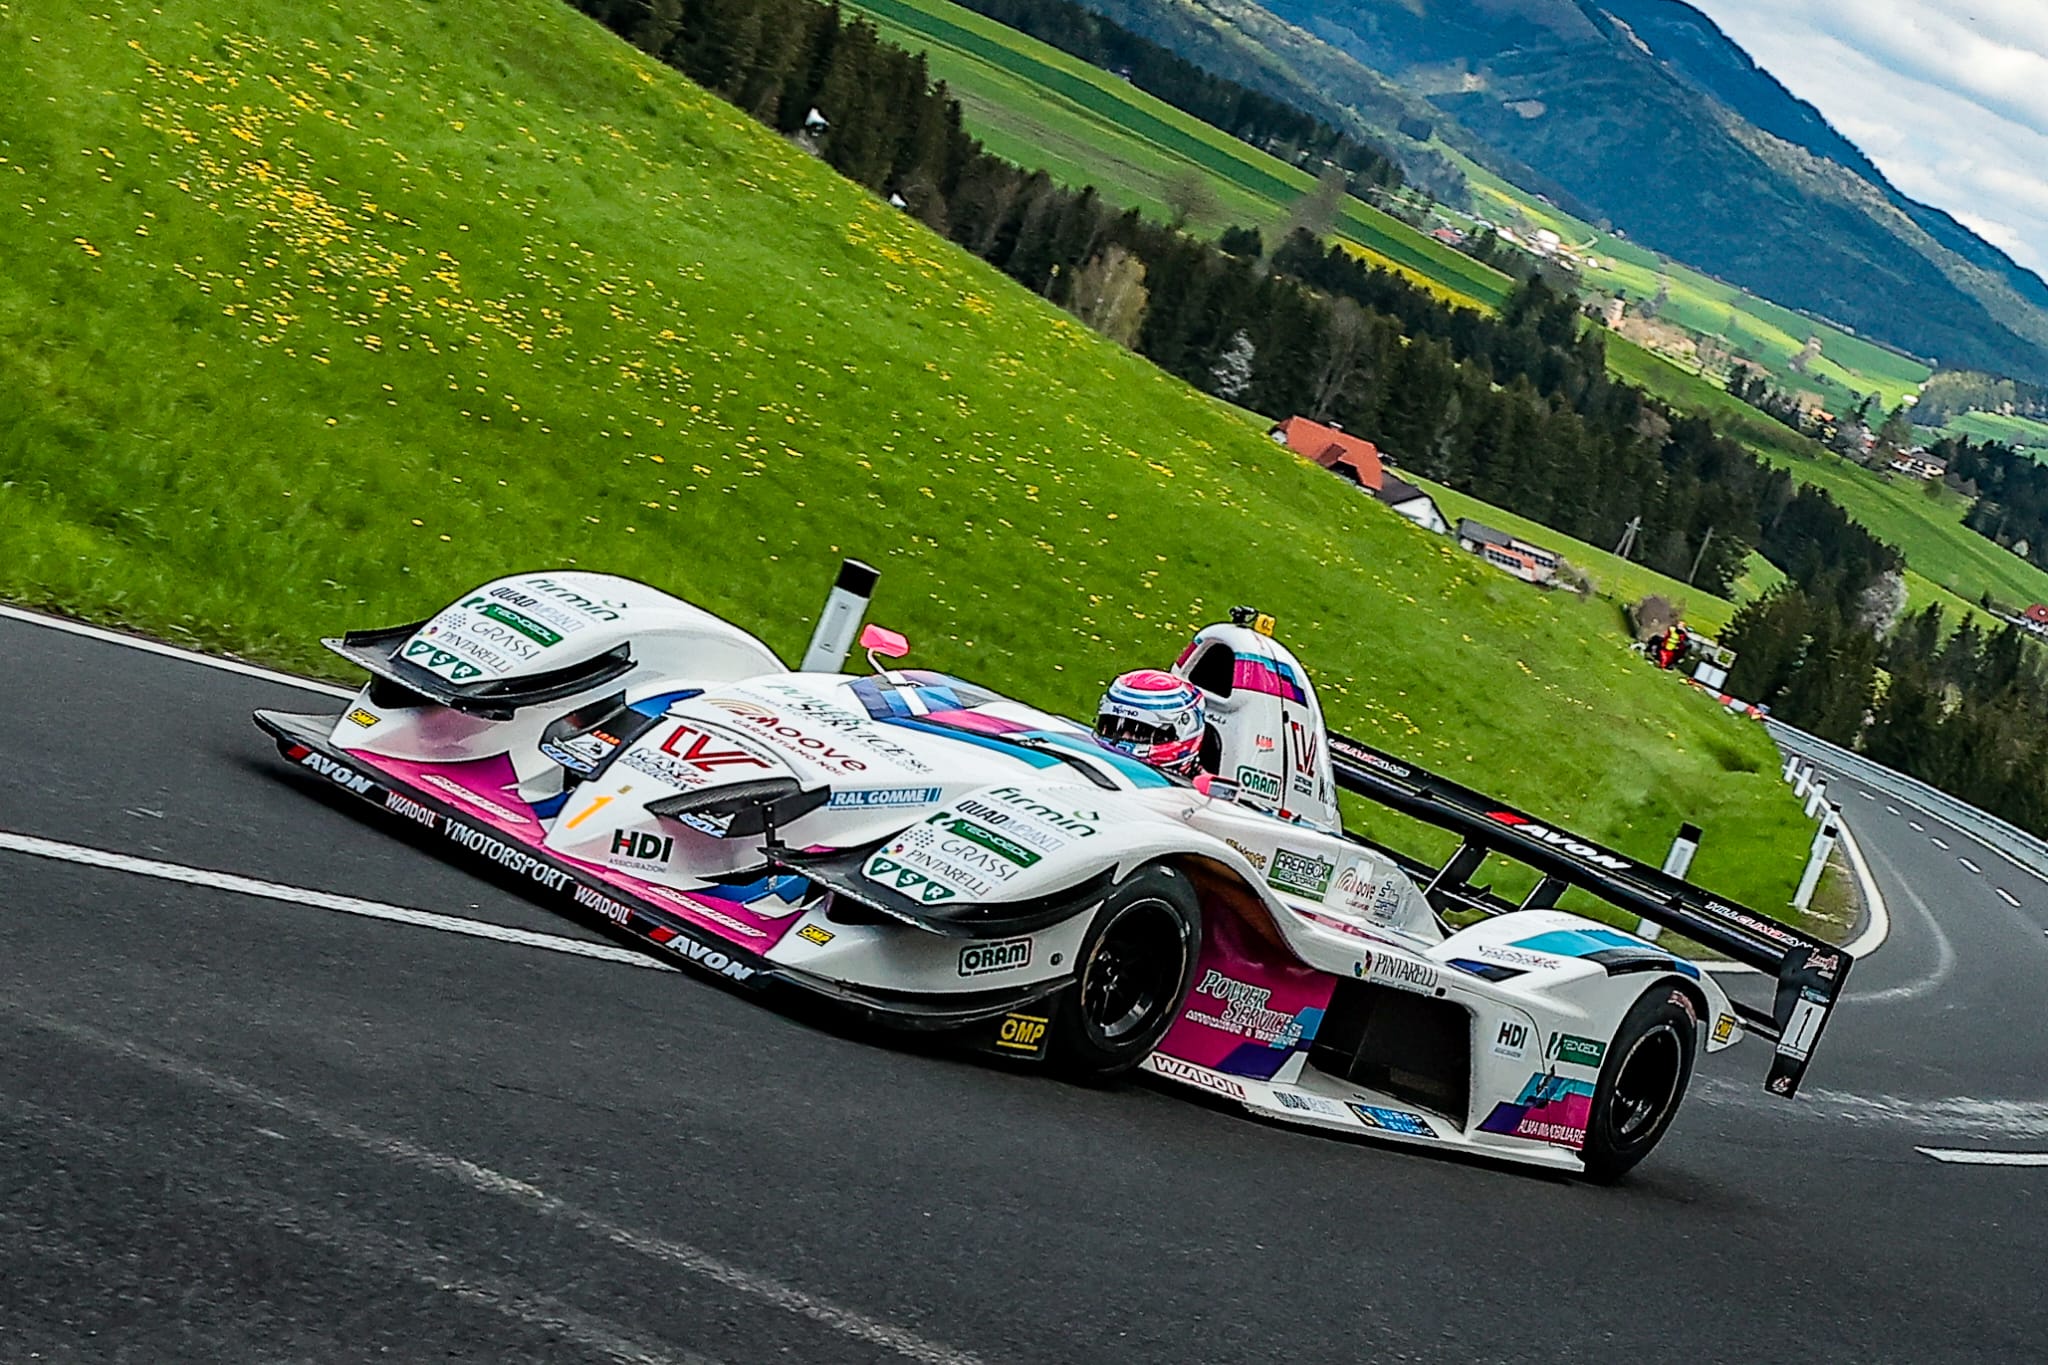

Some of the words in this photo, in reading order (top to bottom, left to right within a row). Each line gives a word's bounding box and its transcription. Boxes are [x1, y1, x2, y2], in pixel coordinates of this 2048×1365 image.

[471, 621, 541, 661] GRASSI
[350, 709, 378, 726] OMP
[868, 789, 927, 804] GOMME
[1241, 771, 1278, 796] ORAM
[989, 786, 1097, 838] firmin
[610, 829, 674, 863] HDI
[941, 839, 1020, 882] GRASSI
[1514, 822, 1633, 870] AVON
[302, 752, 376, 794] AVON
[444, 817, 574, 892] VIMOTORSPORT
[666, 934, 756, 981] AVON
[801, 927, 830, 943] OMP
[964, 943, 1027, 969] ORAM
[1196, 968, 1272, 1010] POWER
[1001, 1018, 1045, 1044] OMP
[1497, 1021, 1528, 1050] HDI
[1795, 1006, 1813, 1048] 1
[1155, 1056, 1246, 1098] WLADOIL
